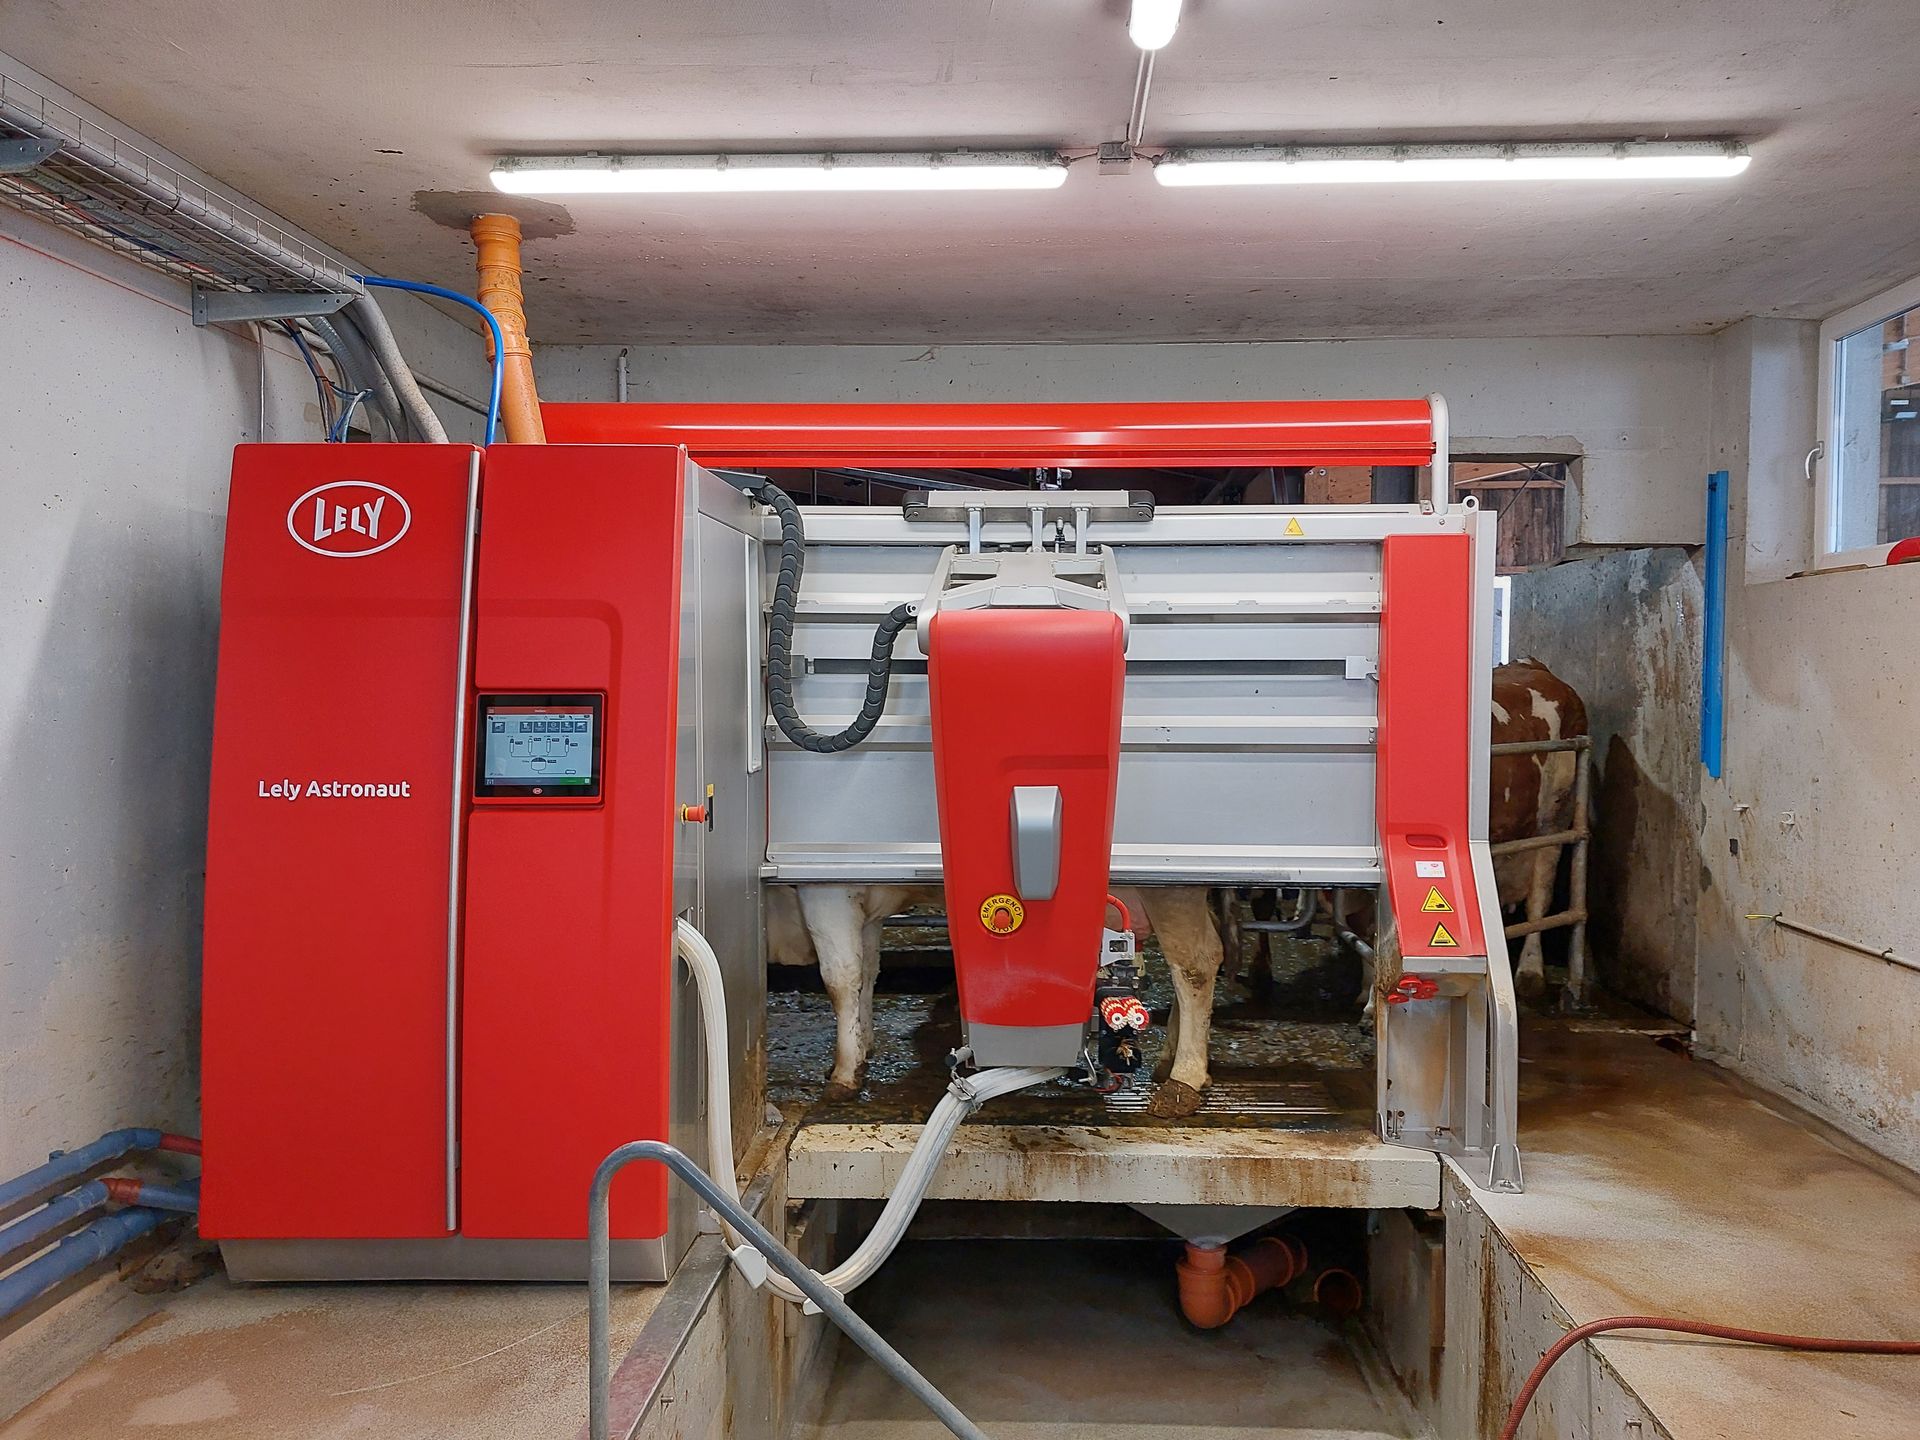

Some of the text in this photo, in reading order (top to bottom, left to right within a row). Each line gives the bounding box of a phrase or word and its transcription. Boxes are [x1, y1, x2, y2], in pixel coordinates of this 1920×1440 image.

[313, 495, 386, 542] LELY
[258, 779, 411, 801] Lely Astronaut
[982, 897, 1022, 919] EMERGENCY
